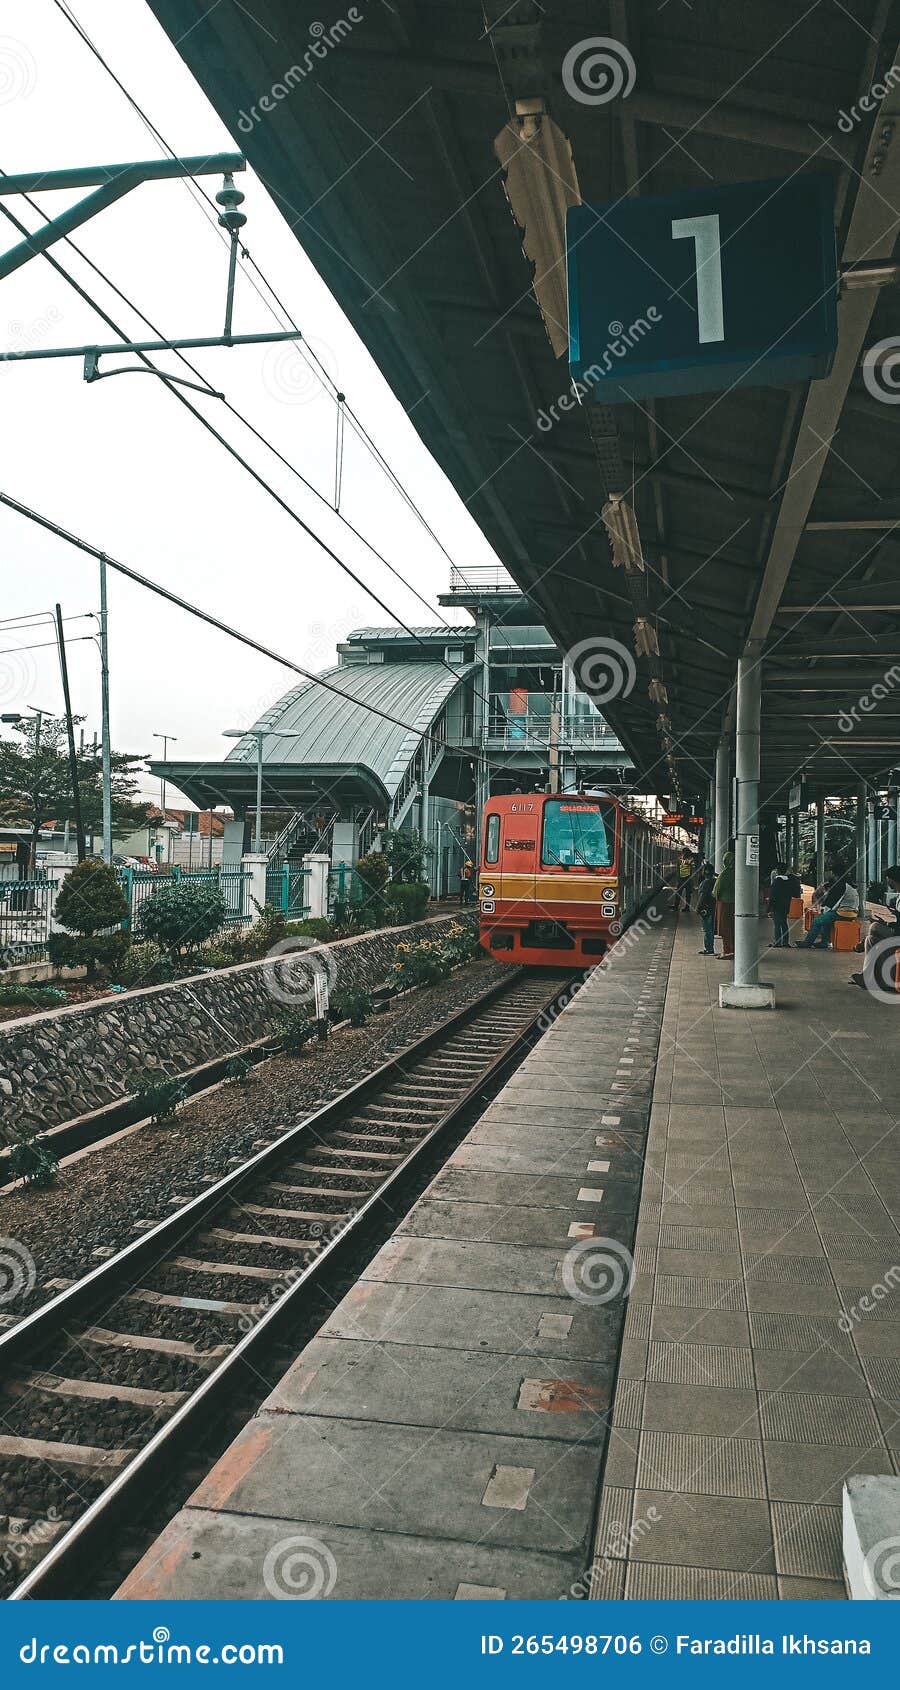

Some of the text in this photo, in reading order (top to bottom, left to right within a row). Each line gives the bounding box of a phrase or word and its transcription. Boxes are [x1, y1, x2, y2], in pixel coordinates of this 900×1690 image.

[671, 213, 725, 344] 1
[511, 803, 534, 812] 6117
[690, 804, 696, 816] 1
[881, 807, 890, 819] 2
